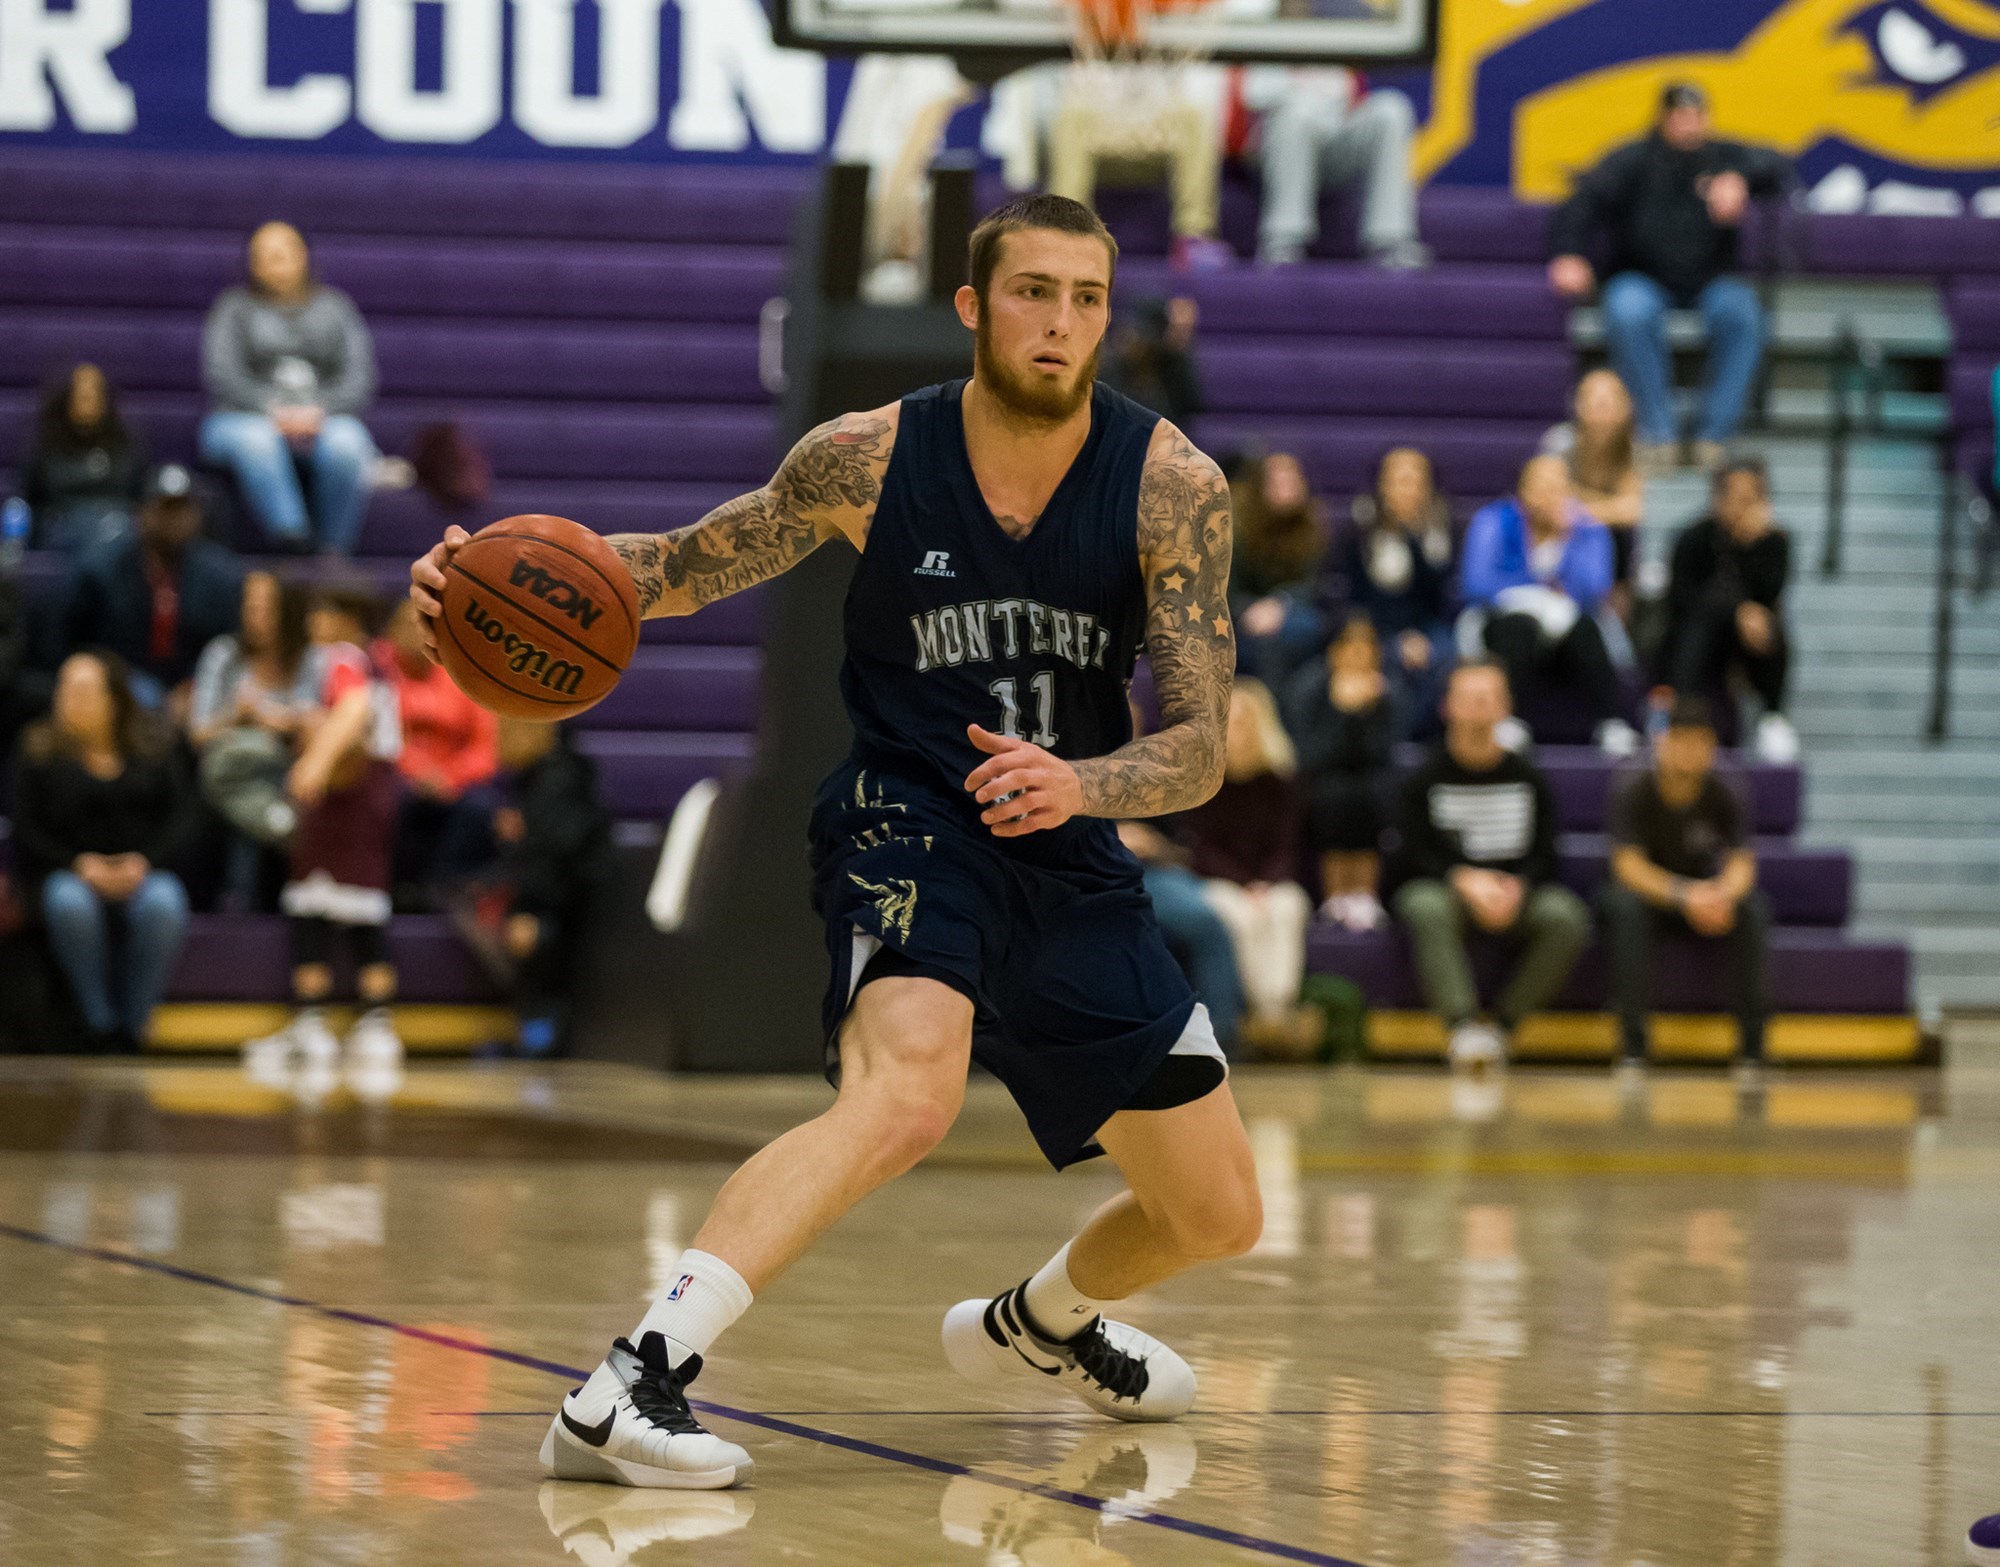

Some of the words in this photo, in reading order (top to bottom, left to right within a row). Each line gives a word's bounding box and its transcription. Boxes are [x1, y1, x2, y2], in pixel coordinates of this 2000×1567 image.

[509, 559, 603, 630] NCAA
[913, 567, 956, 577] RUSSELL
[463, 598, 585, 695] Wilson
[989, 670, 1059, 748] 11
